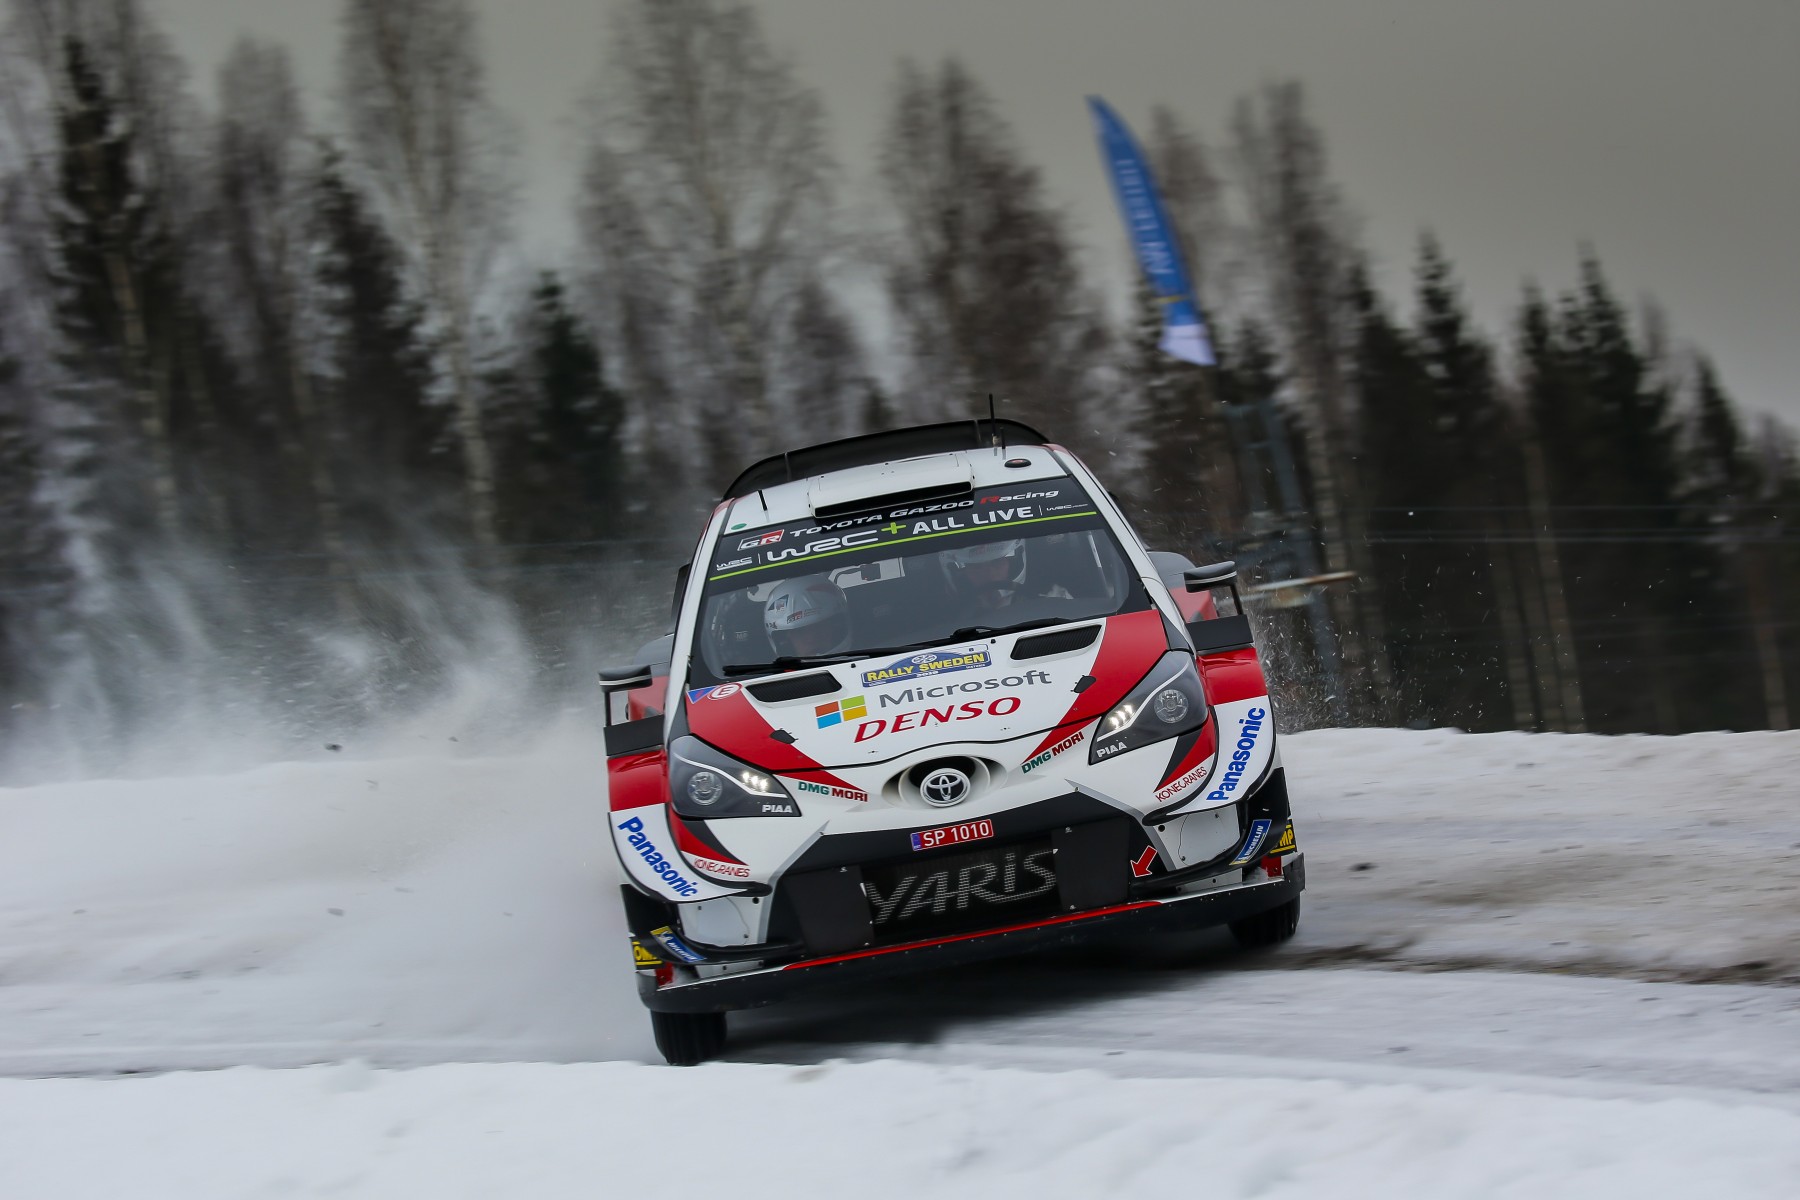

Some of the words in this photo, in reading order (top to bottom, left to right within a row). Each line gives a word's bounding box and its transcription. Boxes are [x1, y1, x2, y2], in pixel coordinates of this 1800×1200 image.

[740, 533, 781, 550] GR
[790, 514, 882, 537] TOYOTA
[889, 500, 974, 518] GAZOO
[980, 490, 1060, 504] Racing
[912, 517, 965, 535] ALL
[972, 506, 1034, 525] LIVE
[867, 665, 914, 682] RALLY
[918, 653, 985, 672] SWEDEN
[879, 670, 1052, 708] Microsoft
[854, 697, 1022, 743] DENSO
[1021, 751, 1052, 774] DMG
[1052, 731, 1085, 757] MORI
[1096, 741, 1127, 758] PIAA
[1206, 707, 1266, 801] Panasonic
[798, 780, 830, 796] DMG
[831, 788, 868, 802] MORI
[1155, 766, 1208, 803] KONECRANES
[762, 803, 793, 814] PIAA
[922, 830, 946, 847] SP
[950, 821, 990, 842] 1010
[617, 816, 699, 897] Panasonic
